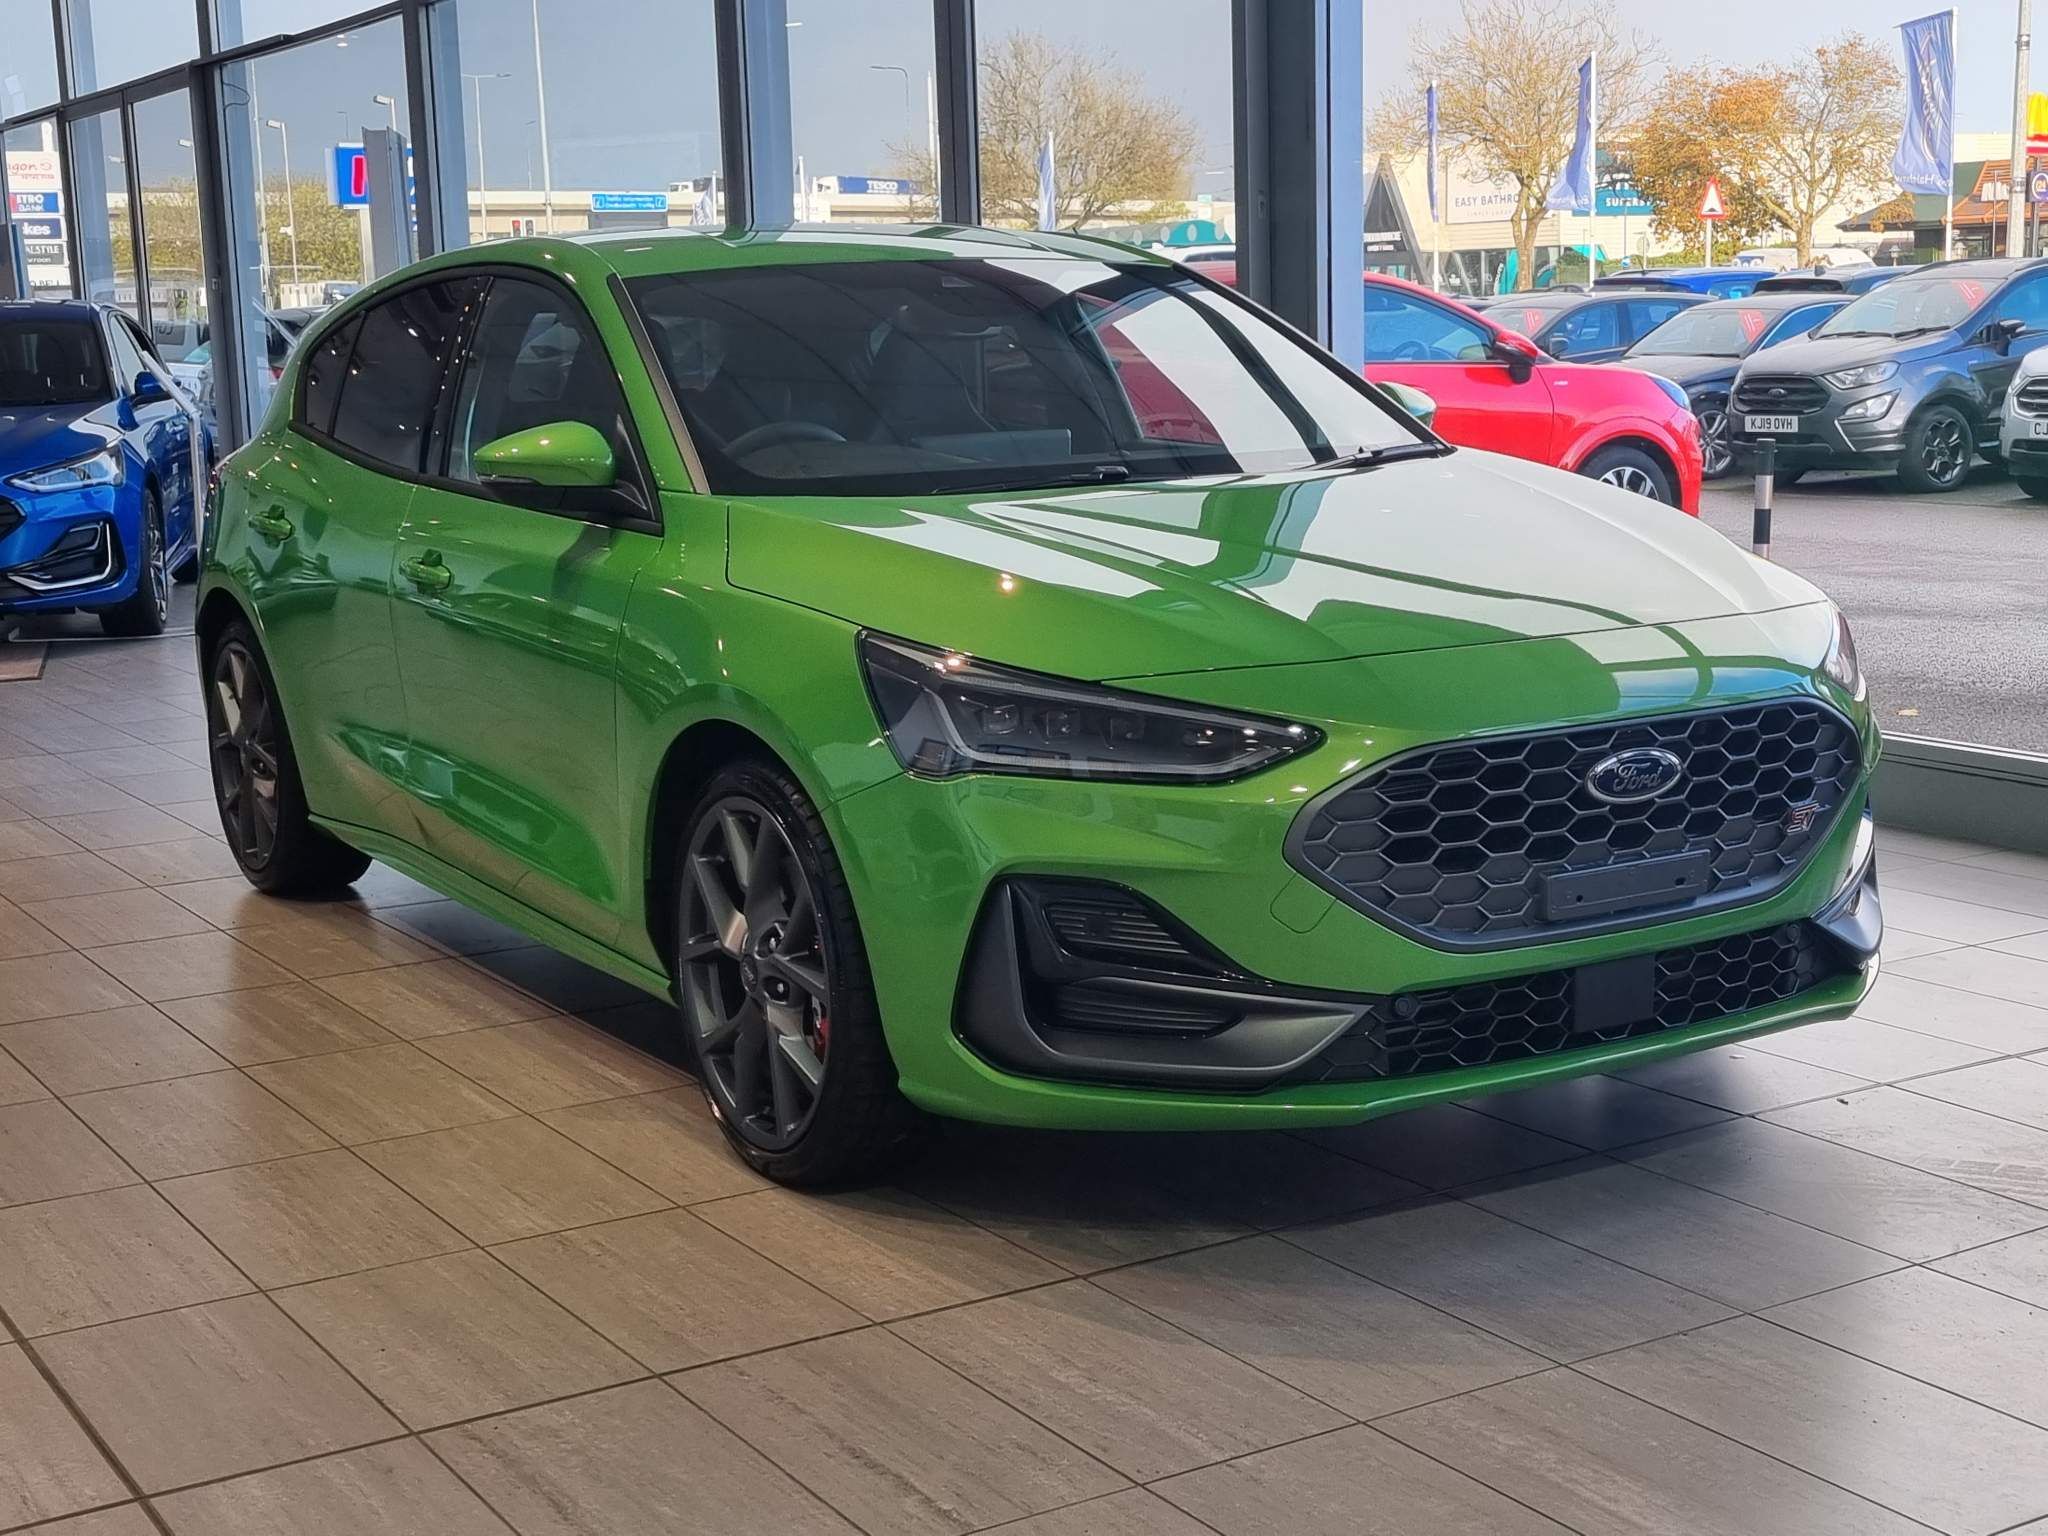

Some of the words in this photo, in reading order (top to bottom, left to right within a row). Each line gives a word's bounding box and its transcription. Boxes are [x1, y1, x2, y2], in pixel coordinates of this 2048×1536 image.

[867, 181, 898, 190] TESCO
[1455, 196, 1477, 207] EASY
[1481, 194, 1519, 206] BATHRO
[22, 222, 51, 235] kes
[1751, 418, 1772, 429] KJ19
[1774, 418, 1792, 429] OVH
[1612, 762, 1664, 792] Ford
[1787, 803, 1820, 832] ST
